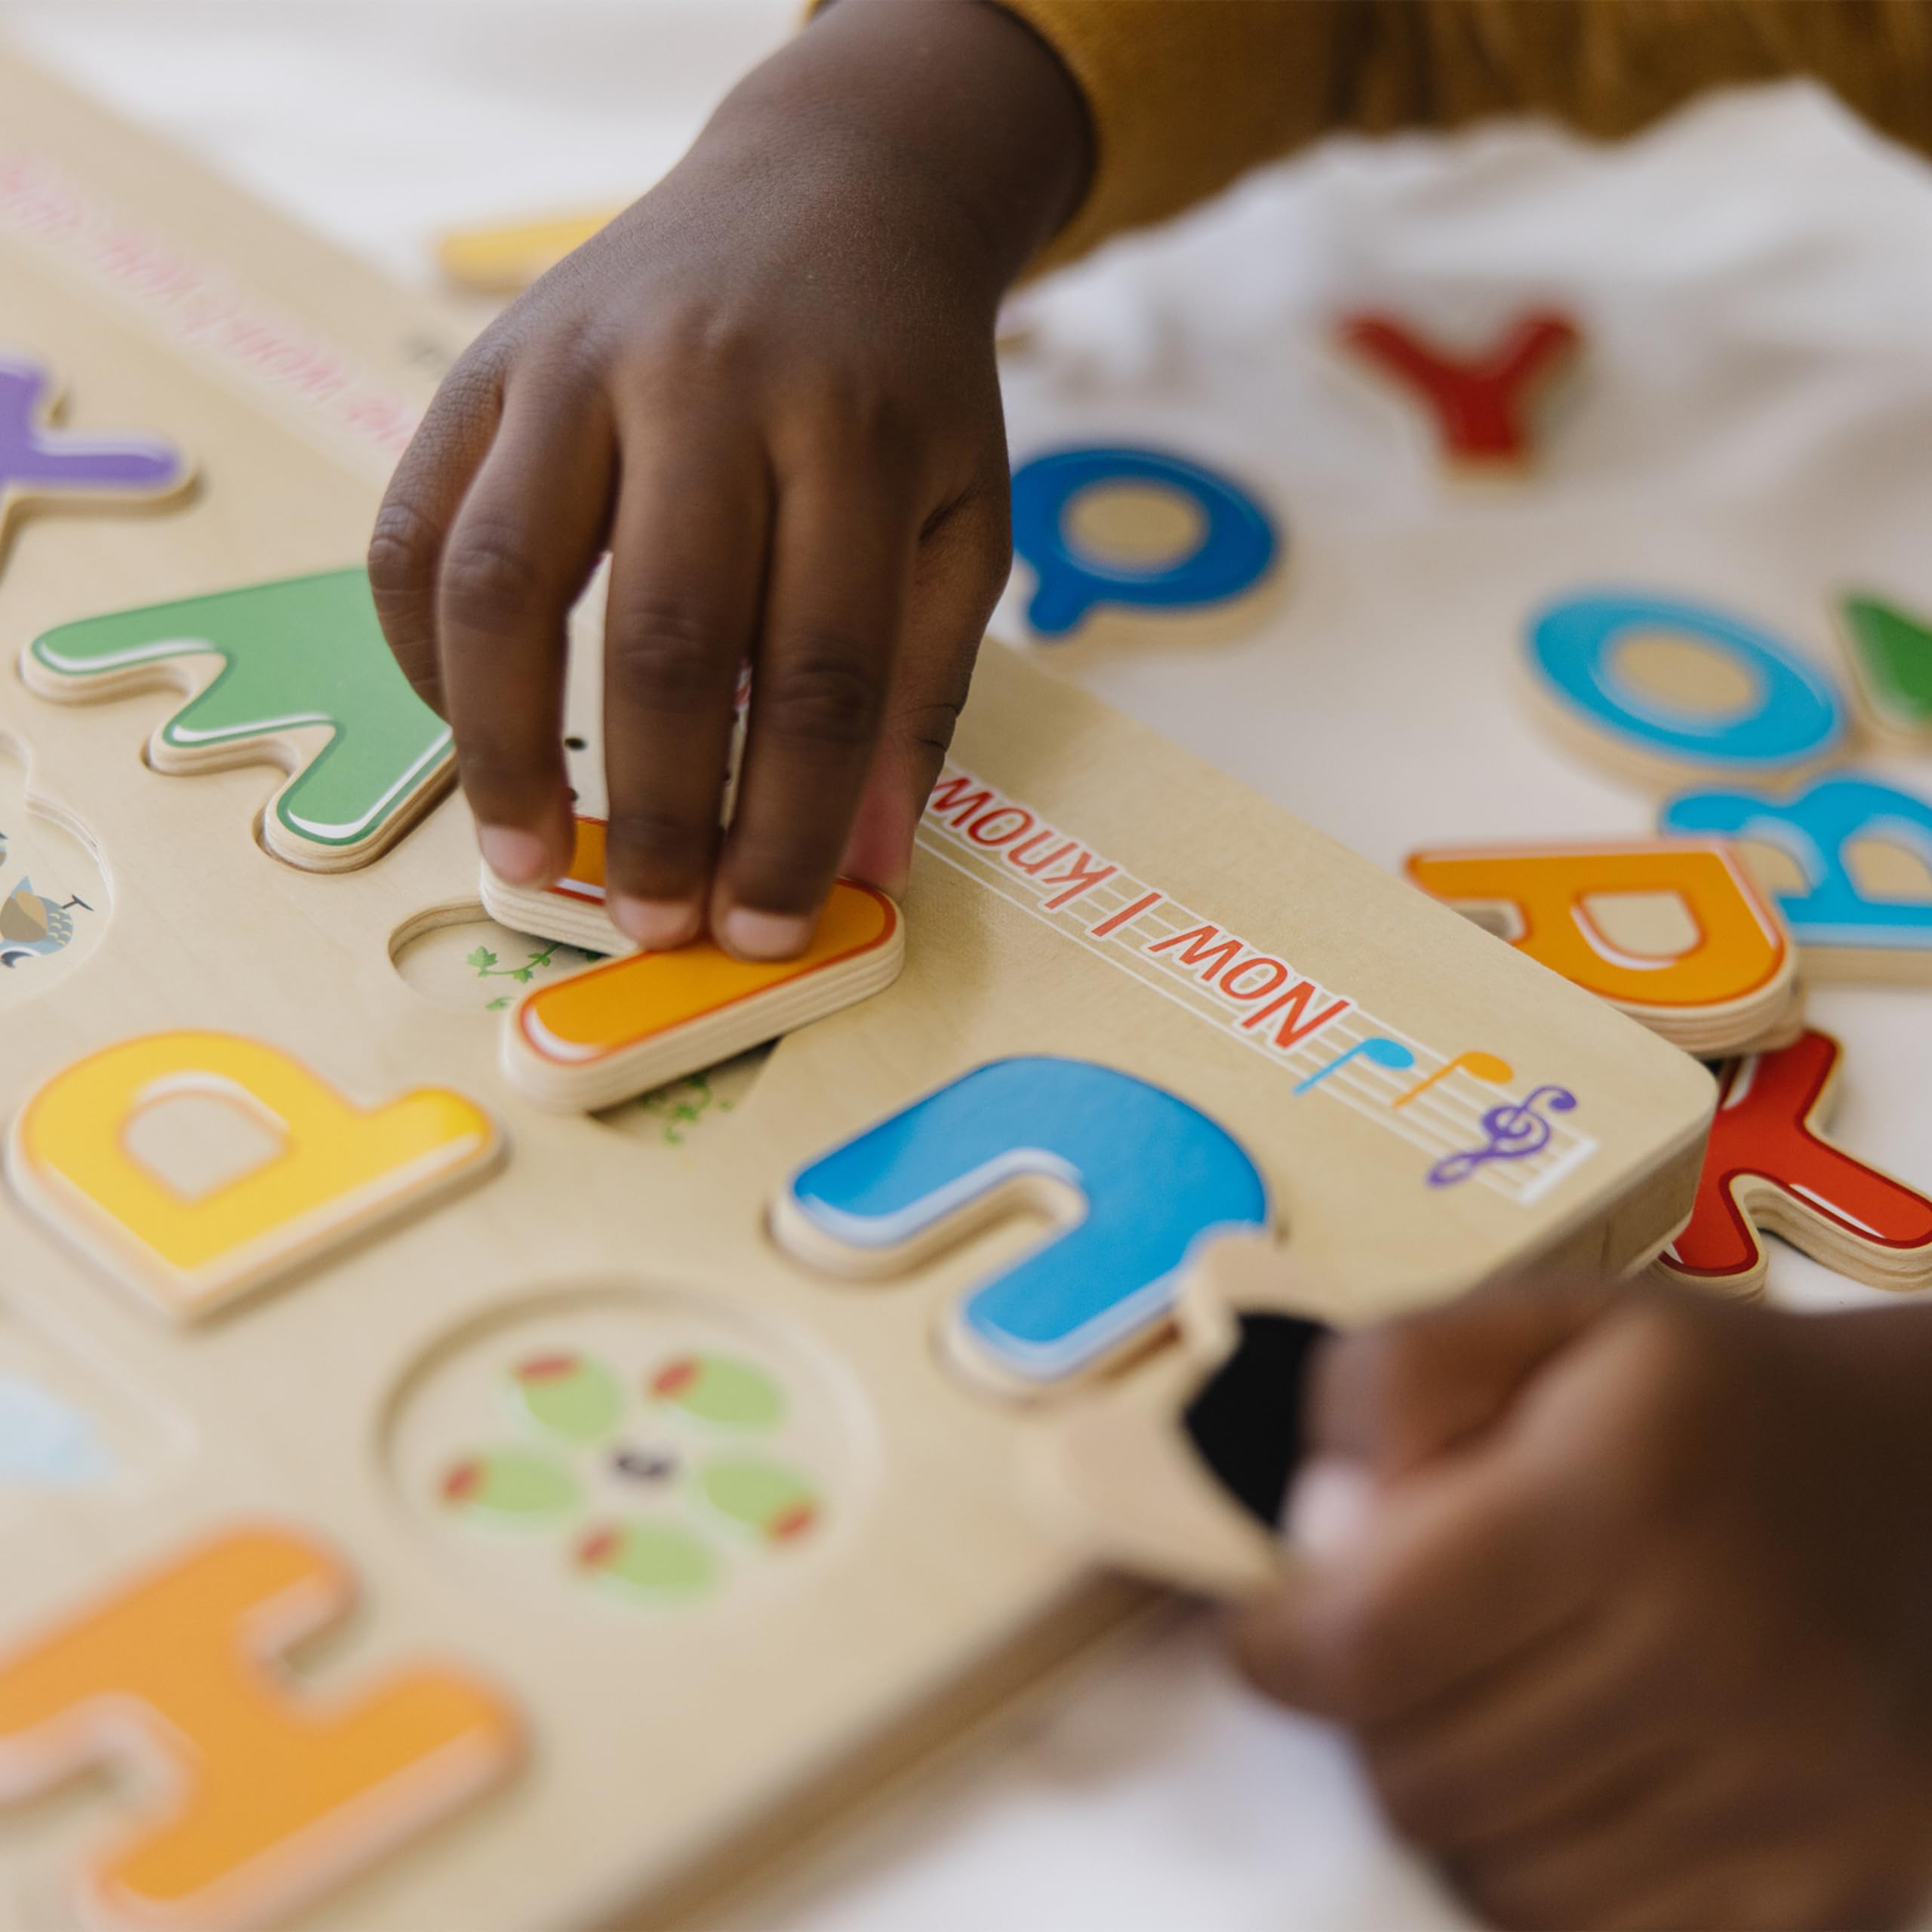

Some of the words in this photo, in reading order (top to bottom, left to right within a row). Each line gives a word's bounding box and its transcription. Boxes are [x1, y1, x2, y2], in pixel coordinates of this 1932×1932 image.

[1340, 308, 1585, 469] Y
[1011, 444, 1277, 641] Q
[1526, 589, 1849, 766] O
[932, 776, 1118, 911] know
[1091, 891, 1163, 938] I
[1146, 924, 1351, 1050] Now
[17, 1026, 498, 1315] P
[789, 1054, 1271, 1384] U
